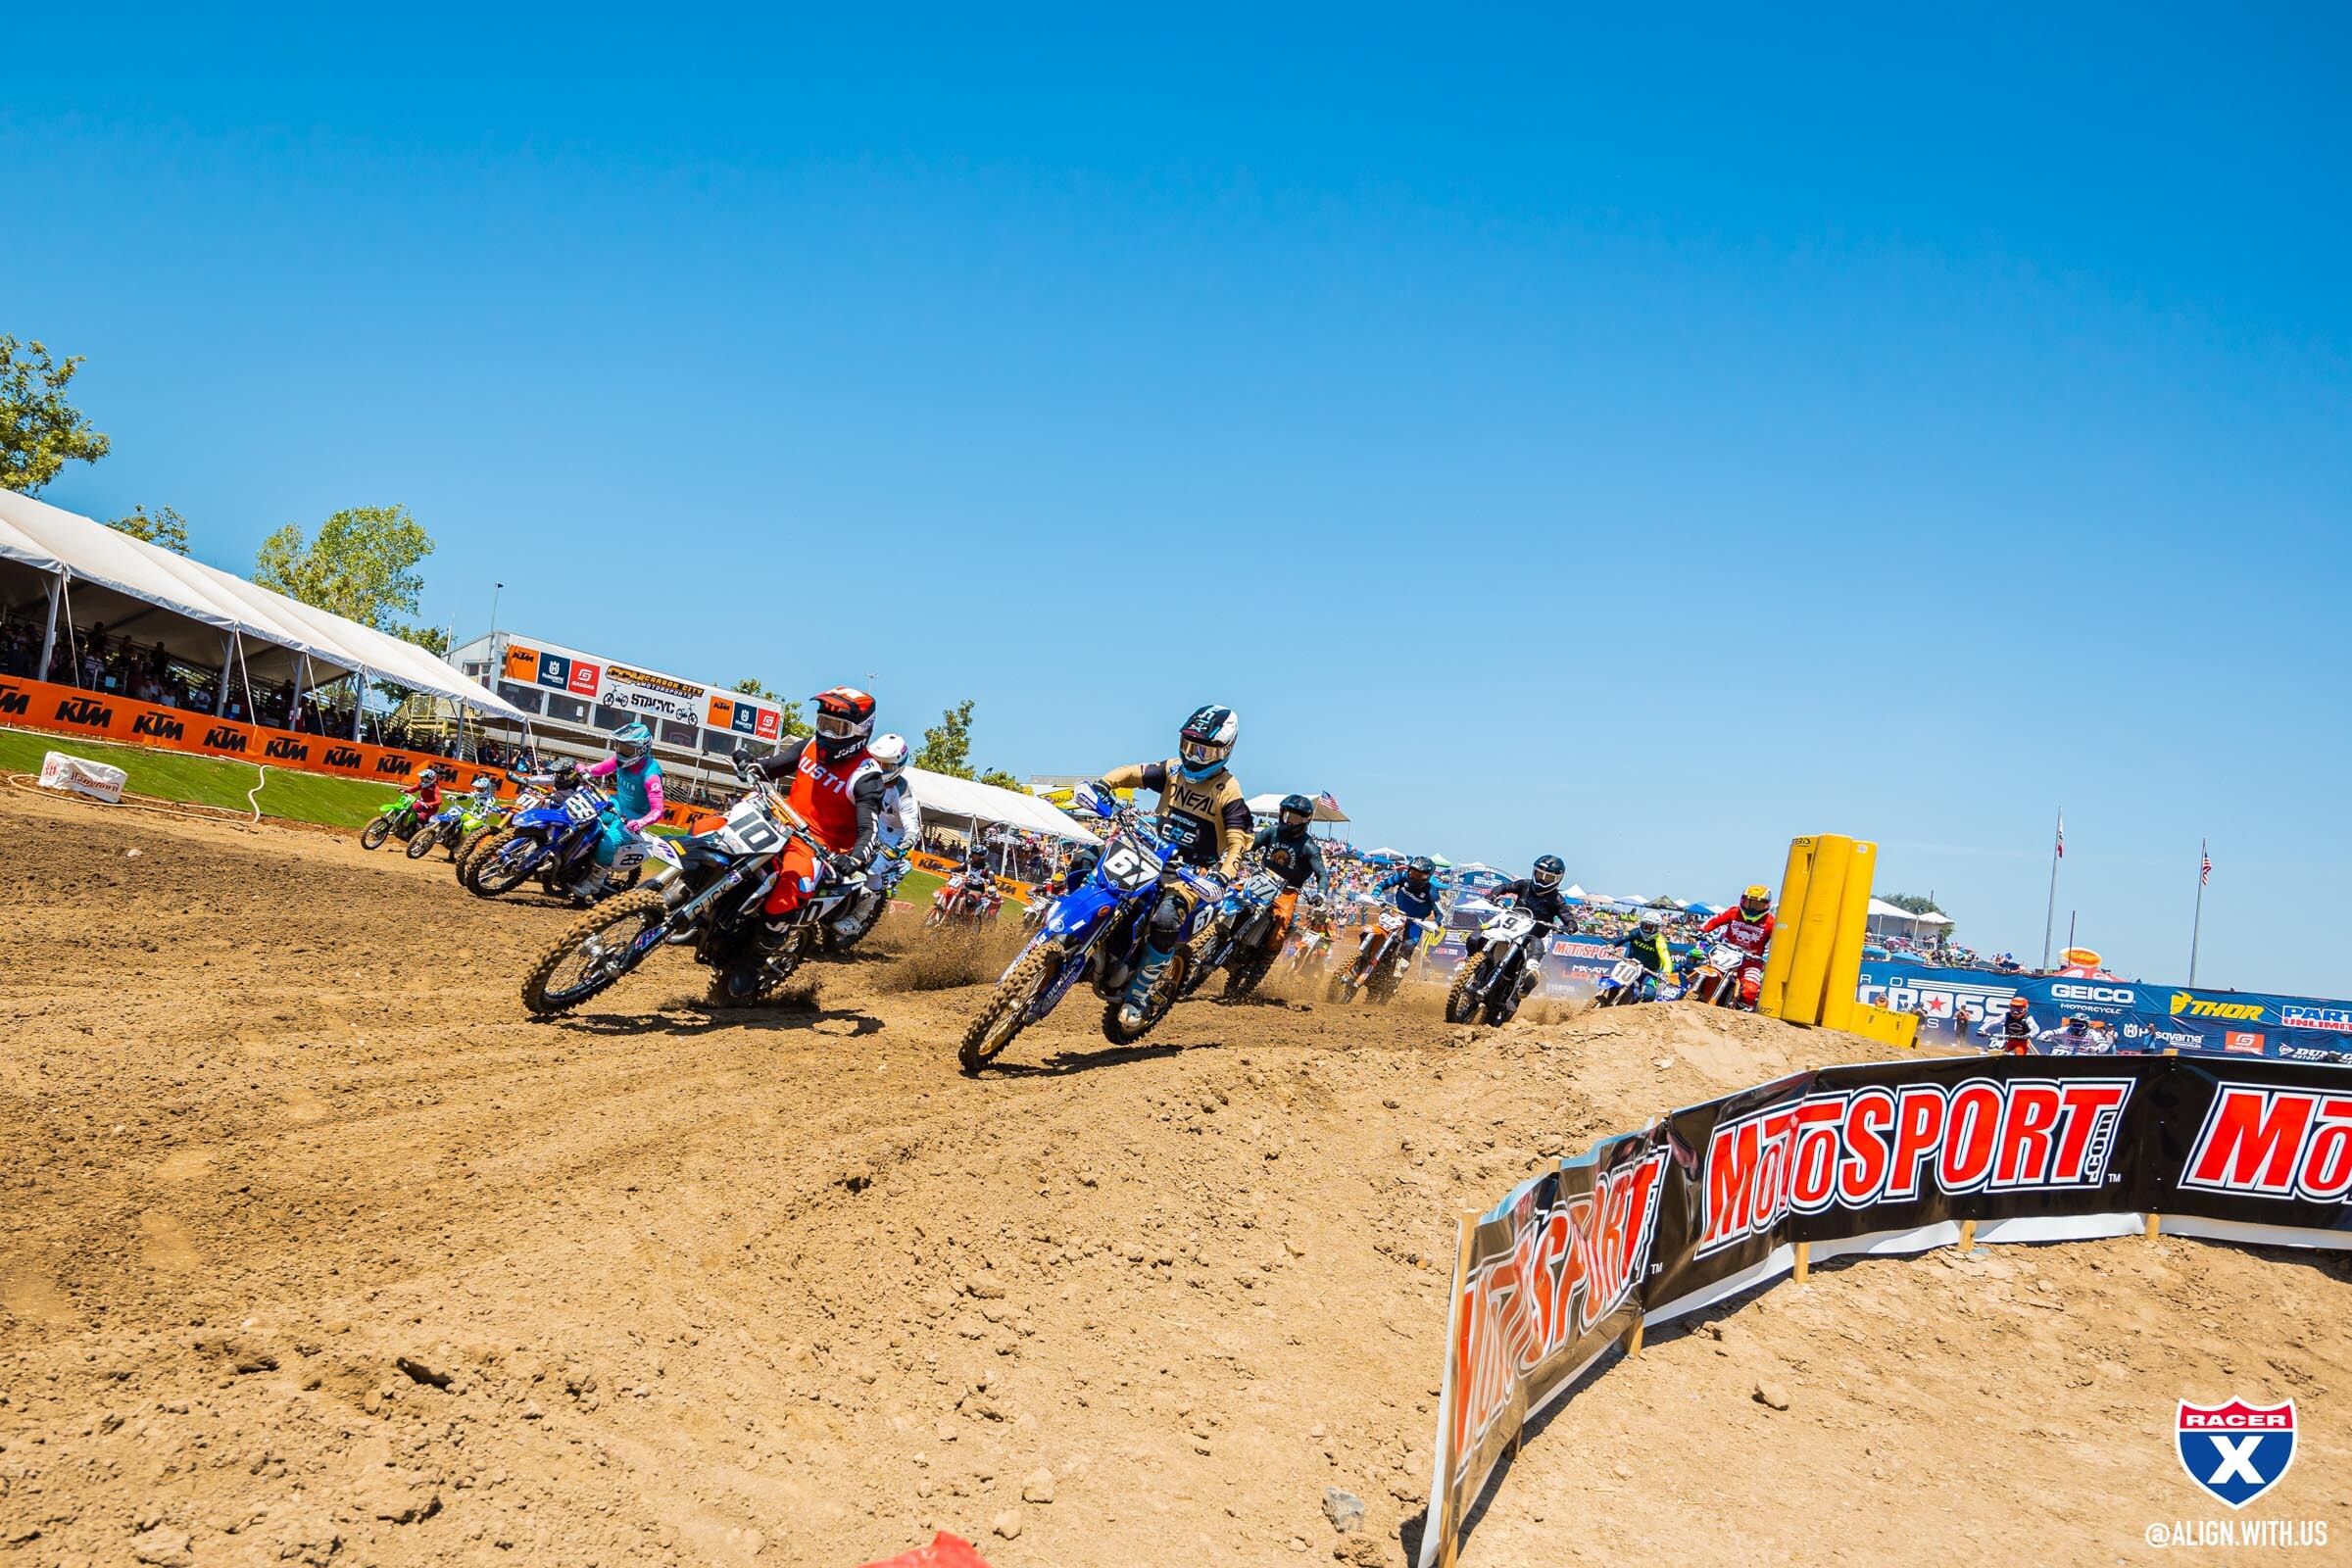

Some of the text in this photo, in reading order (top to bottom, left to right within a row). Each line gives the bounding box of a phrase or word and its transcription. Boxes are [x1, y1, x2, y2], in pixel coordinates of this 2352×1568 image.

[512, 651, 535, 662] KTM
[570, 680, 595, 691] GASGAS
[640, 681, 693, 699] MOTORSPORTS
[643, 675, 704, 695] CARSON CITY
[54, 696, 114, 728] KTM
[630, 693, 676, 714] STACYC
[131, 710, 185, 742] KTM
[203, 725, 247, 754] KTM
[265, 736, 310, 761] KTM
[322, 745, 363, 769] KTM
[375, 754, 413, 776] KTM
[728, 810, 779, 853] 10
[1161, 823, 1198, 845] CRS
[1103, 849, 1160, 885] 67
[1192, 906, 1214, 934] 67
[1617, 964, 1638, 981] 10
[2051, 983, 2134, 1004] GEICO
[2060, 1003, 2123, 1014] MOTORCYCLE
[2191, 1000, 2265, 1021] THOR
[2227, 1044, 2262, 1053] GASGAS
